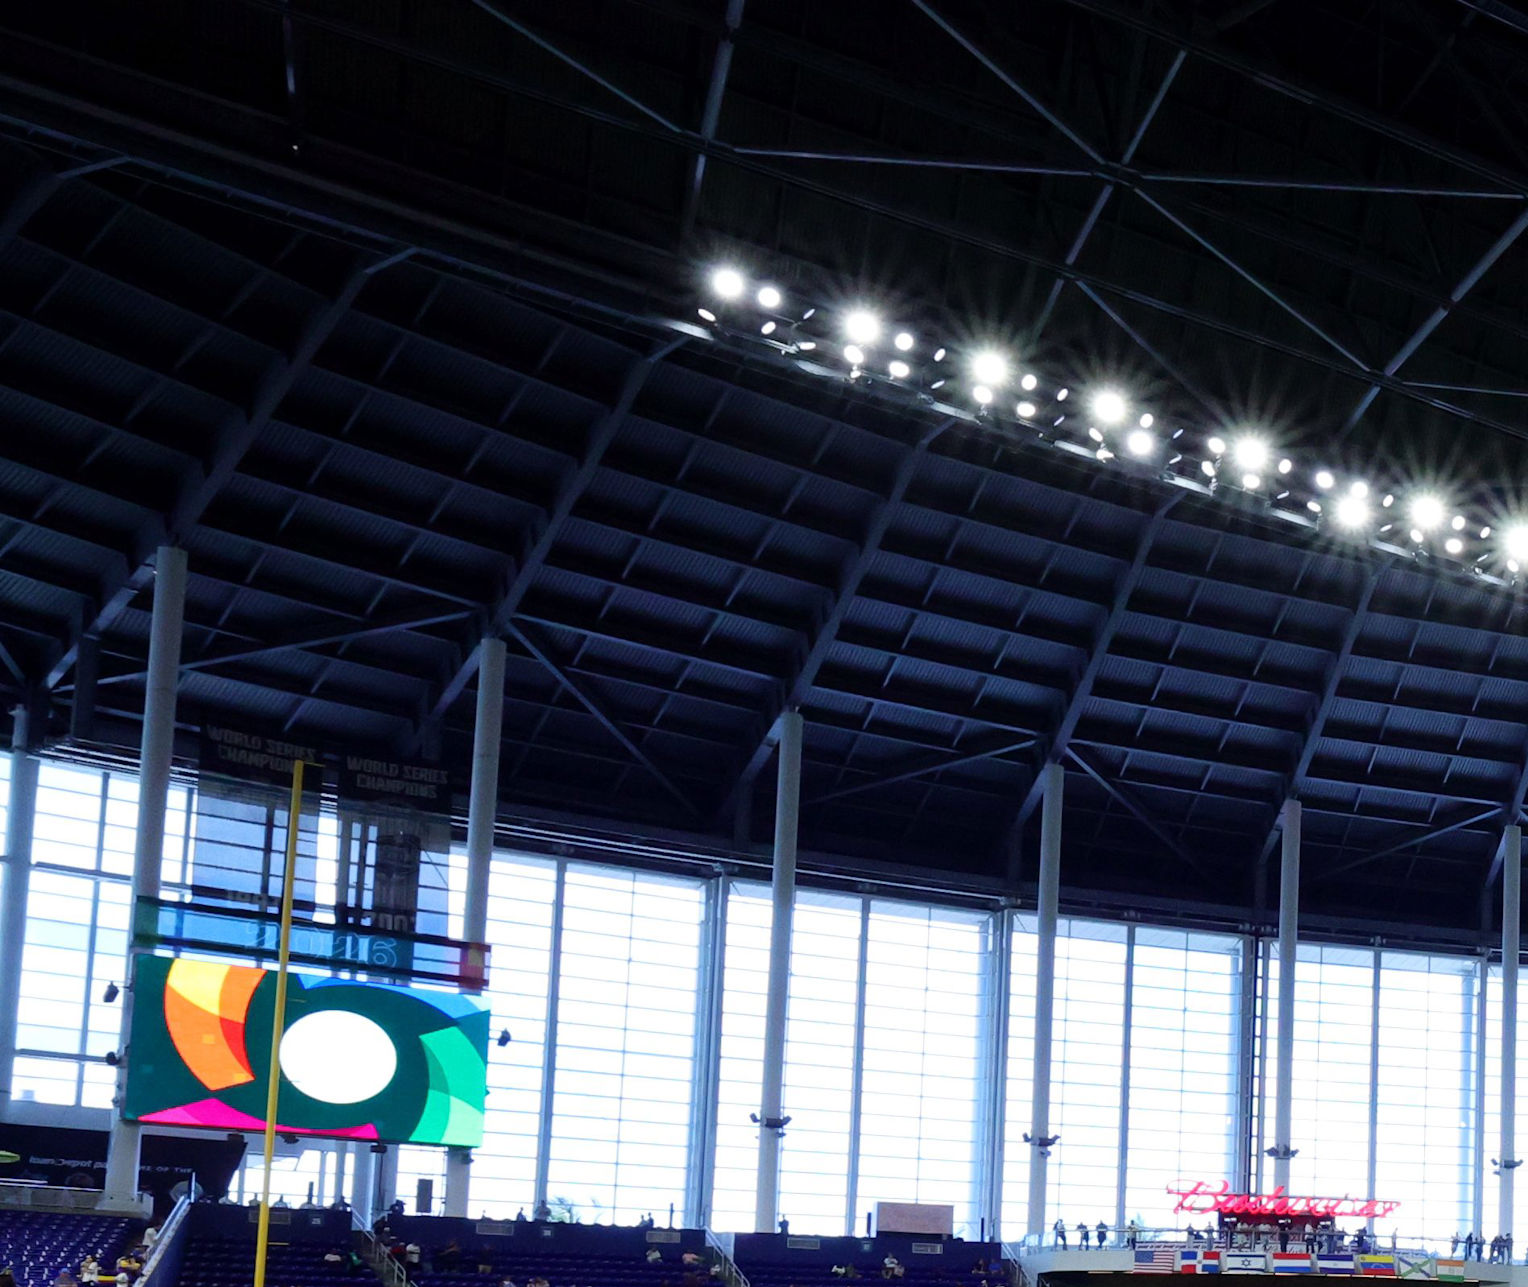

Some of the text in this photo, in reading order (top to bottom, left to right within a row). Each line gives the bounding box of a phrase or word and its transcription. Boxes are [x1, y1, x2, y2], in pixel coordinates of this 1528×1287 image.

[217, 745, 294, 773] CHAMPION
[347, 755, 449, 786] WORLD SERIES
[1166, 1178, 1402, 1218] Budweiser
